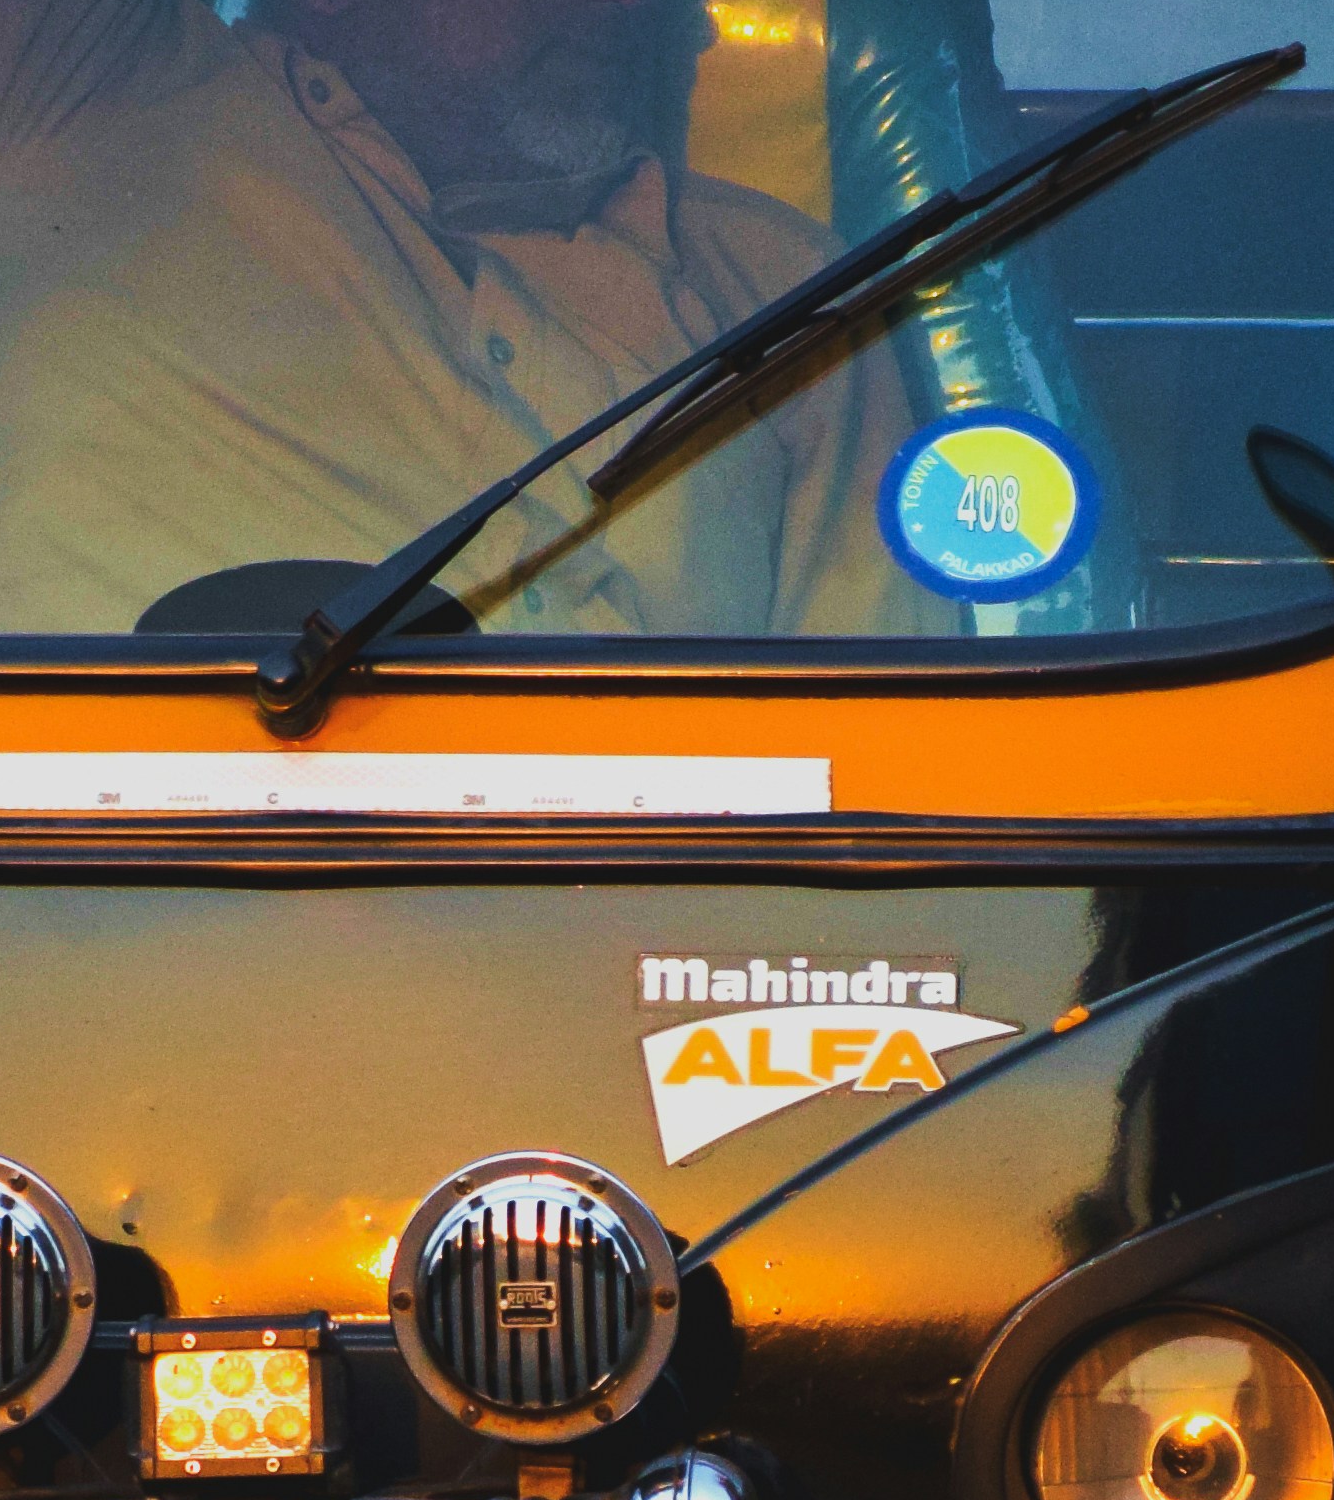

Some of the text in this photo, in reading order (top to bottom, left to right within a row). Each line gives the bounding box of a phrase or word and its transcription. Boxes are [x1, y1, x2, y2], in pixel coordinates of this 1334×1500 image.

[903, 453, 940, 511] TOWN
[957, 474, 1020, 533] 408
[939, 551, 1036, 577] PALAKKAD
[97, 792, 121, 805] 3M
[462, 794, 486, 806] 3M
[642, 957, 958, 1005] Mahindra
[661, 1026, 947, 1090] ALFA
